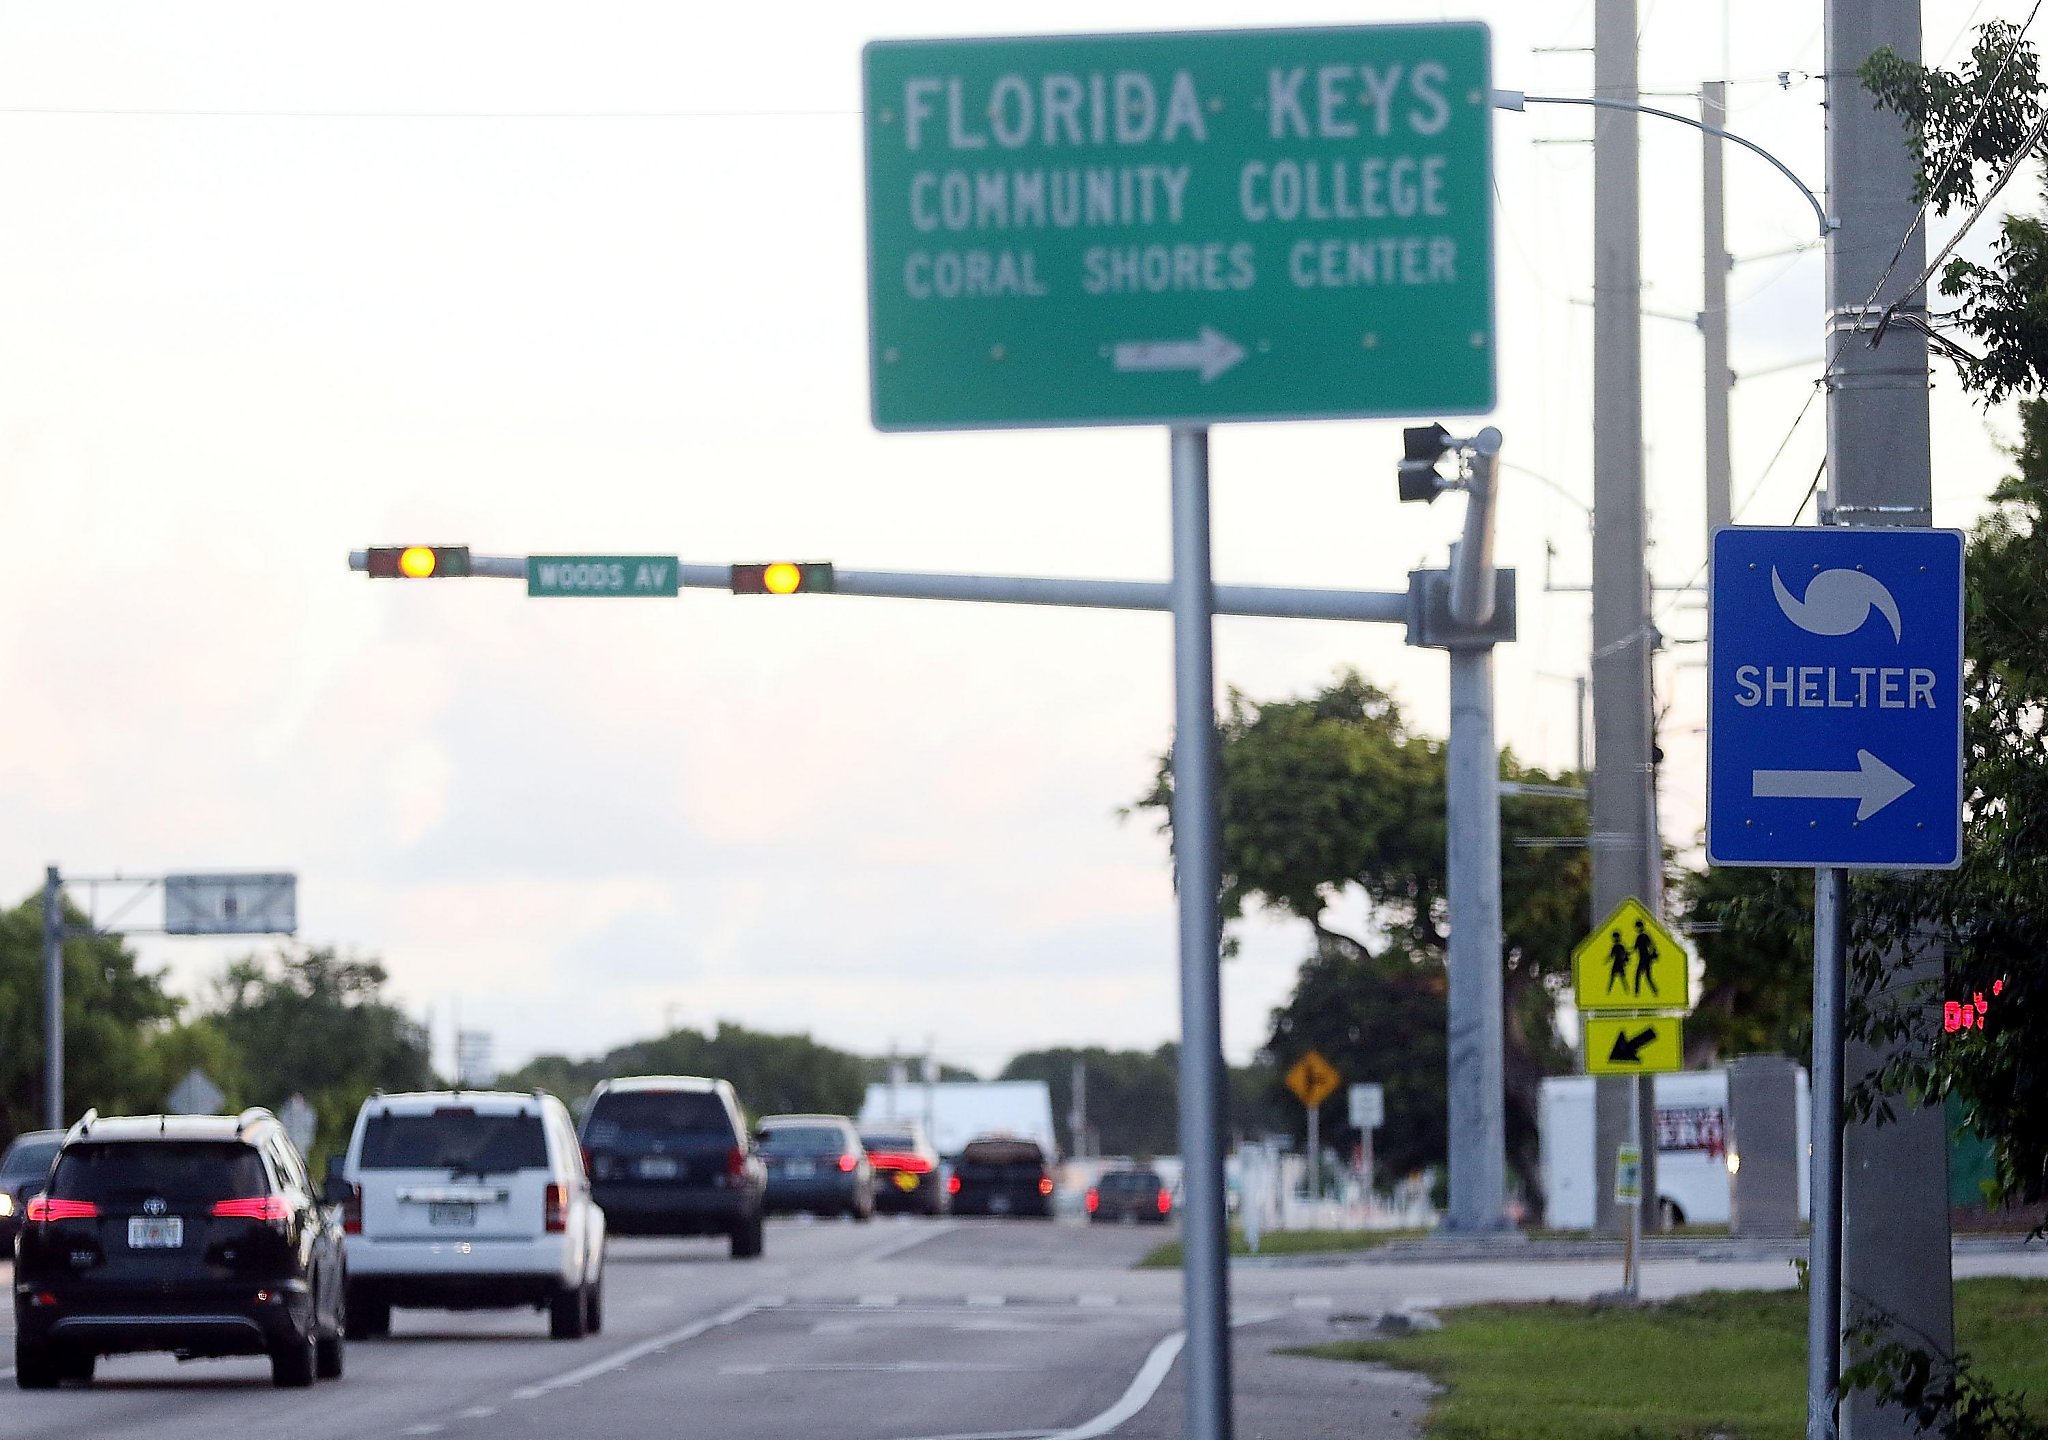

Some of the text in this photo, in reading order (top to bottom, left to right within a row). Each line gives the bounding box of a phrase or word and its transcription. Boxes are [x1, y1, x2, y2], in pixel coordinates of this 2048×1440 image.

[903, 62, 1451, 149] FLORIDA KEYS
[909, 156, 1447, 232] COMMUNITY COLLEGE
[904, 236, 1457, 298] CORAL SHORES CENTER
[537, 563, 668, 590] WOODS AV
[1734, 665, 1936, 709] SHELTER
